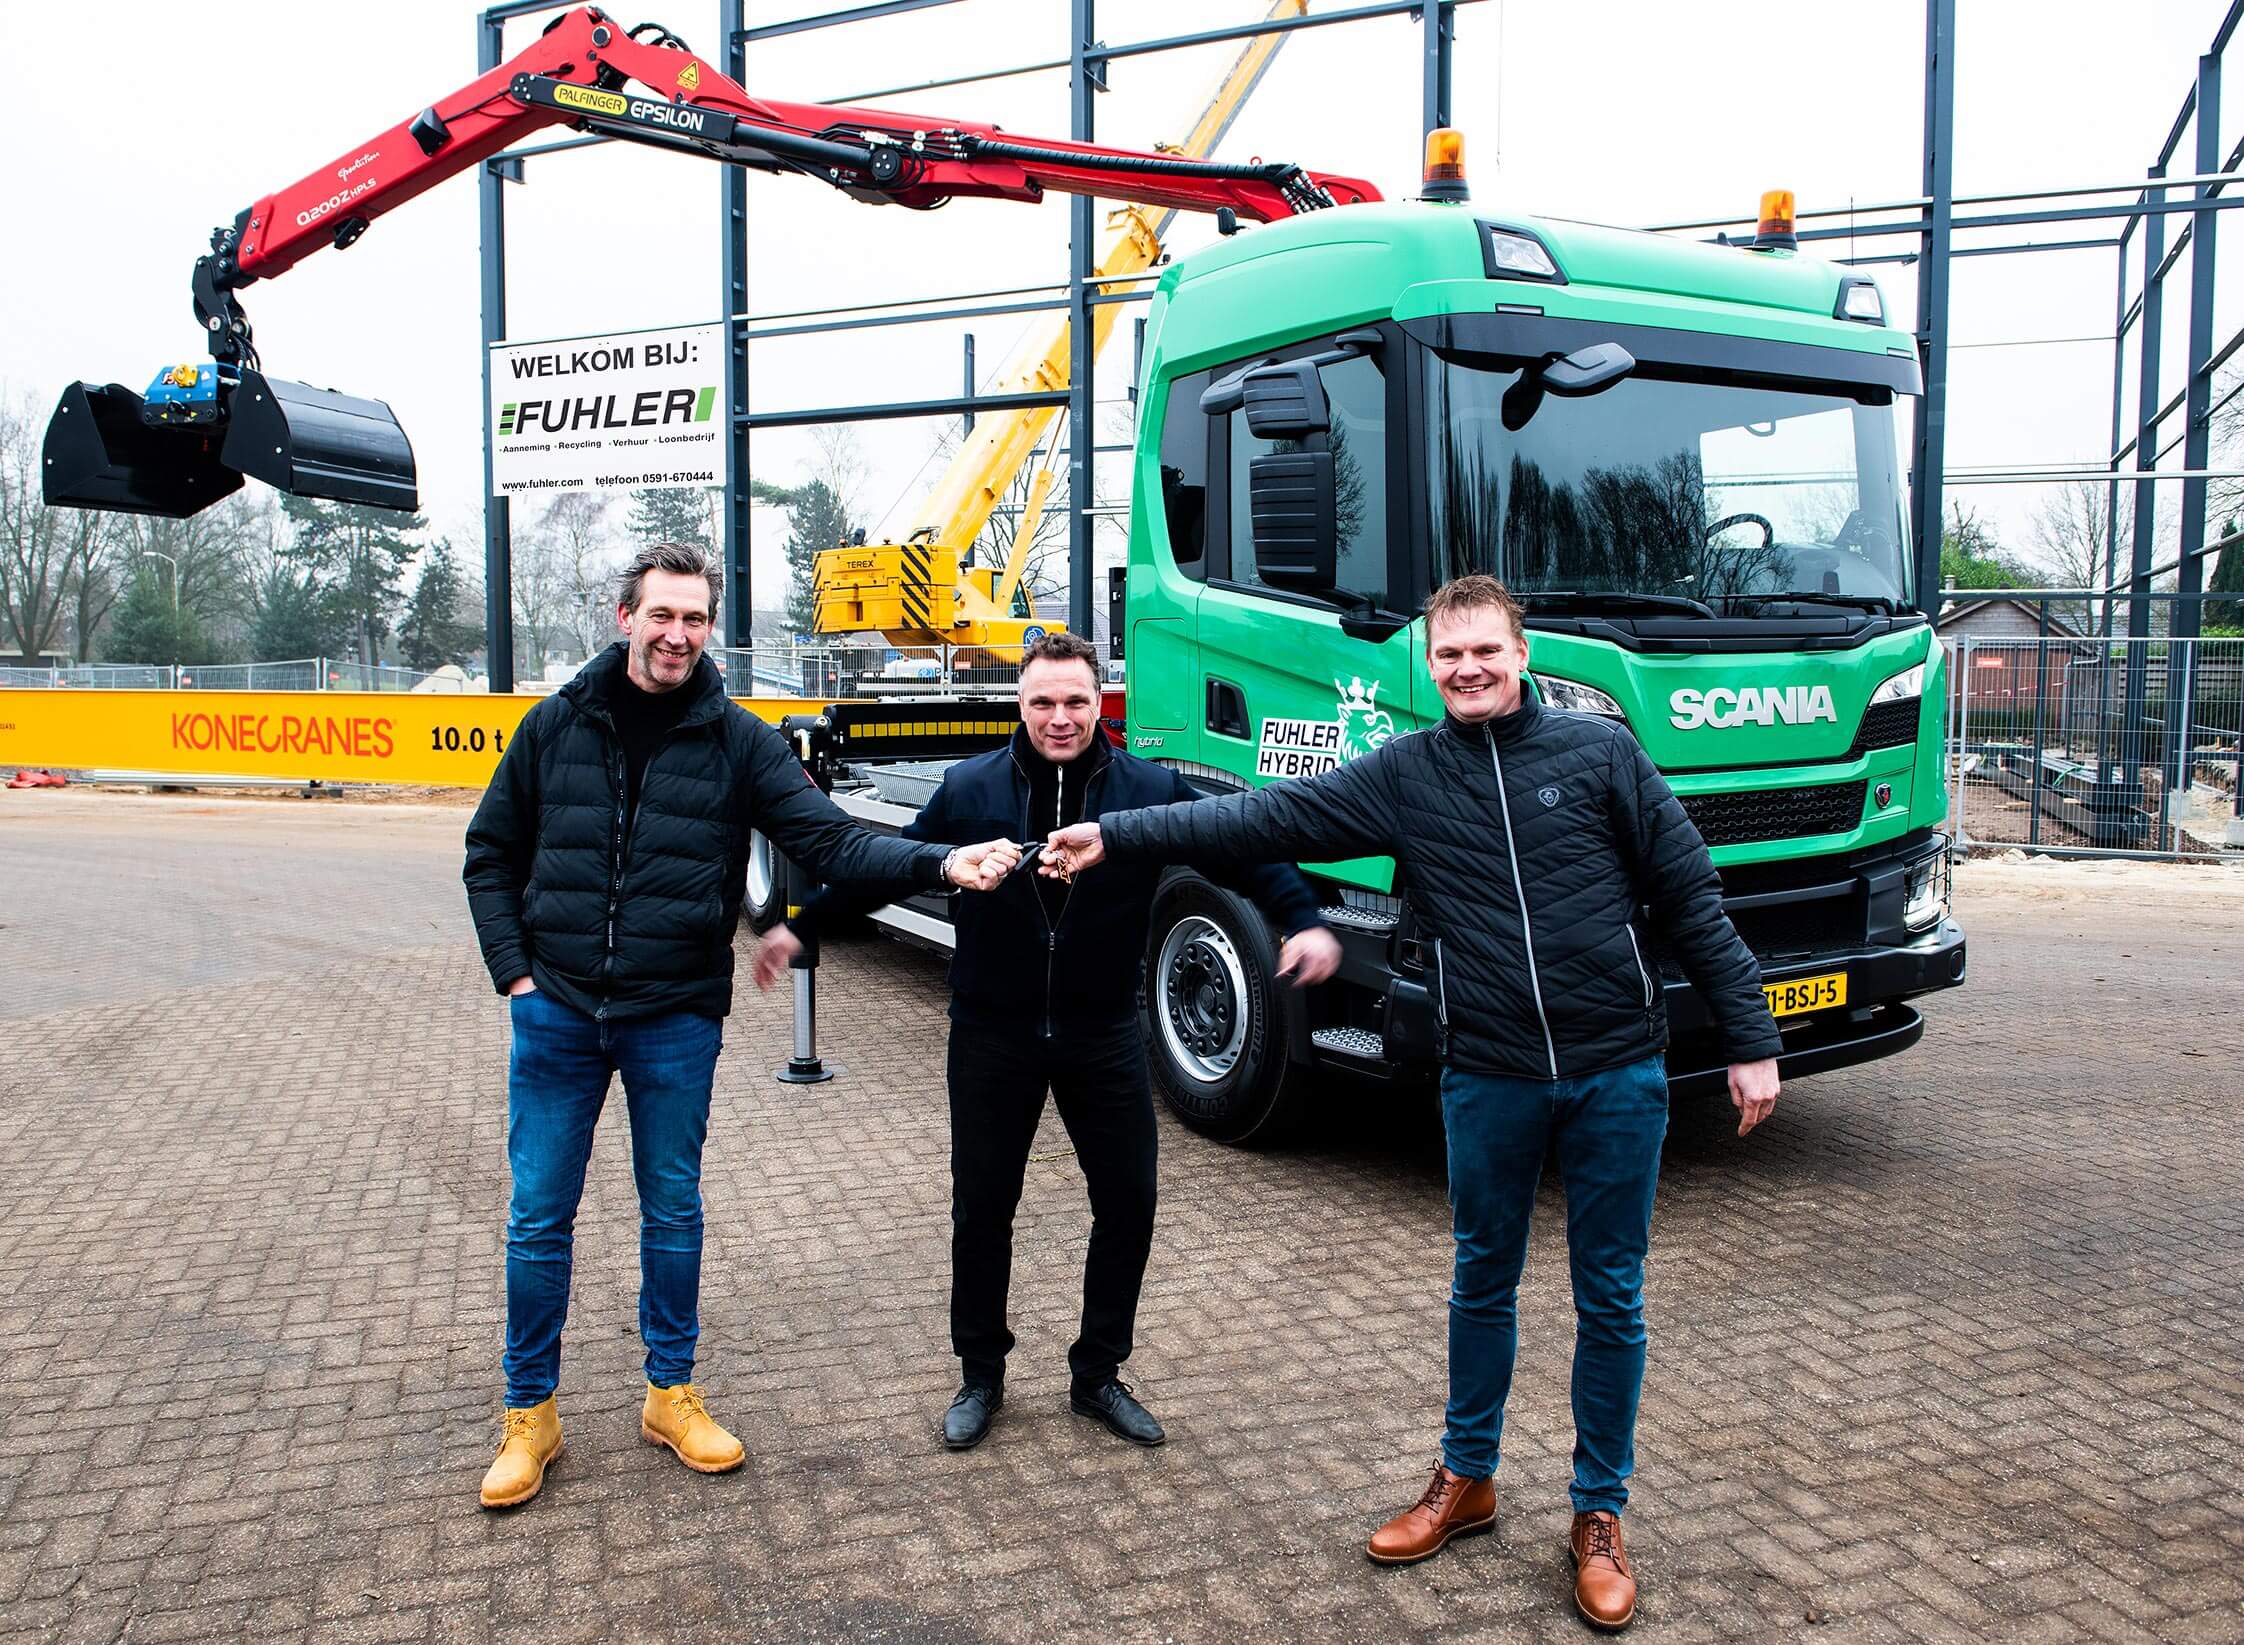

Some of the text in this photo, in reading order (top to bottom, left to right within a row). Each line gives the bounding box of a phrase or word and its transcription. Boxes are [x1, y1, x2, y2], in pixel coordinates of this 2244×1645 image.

[558, 87, 705, 131] PALFINGER EPSILON
[511, 340, 699, 379] WELKOM BIJ:
[515, 388, 697, 434] FUHLER
[502, 432, 716, 454] Aanneming Recycling Verhuur Loonbedrijf
[502, 471, 714, 490] www.fuhler.com telefoon 0591-670444
[846, 559, 874, 569] TEREX
[1668, 685, 1838, 730] SCANIA
[171, 713, 395, 758] KONECRANES
[431, 726, 504, 753] 10.0 t
[1134, 735, 1165, 749] hybrid
[1263, 721, 1340, 749] FUHLER
